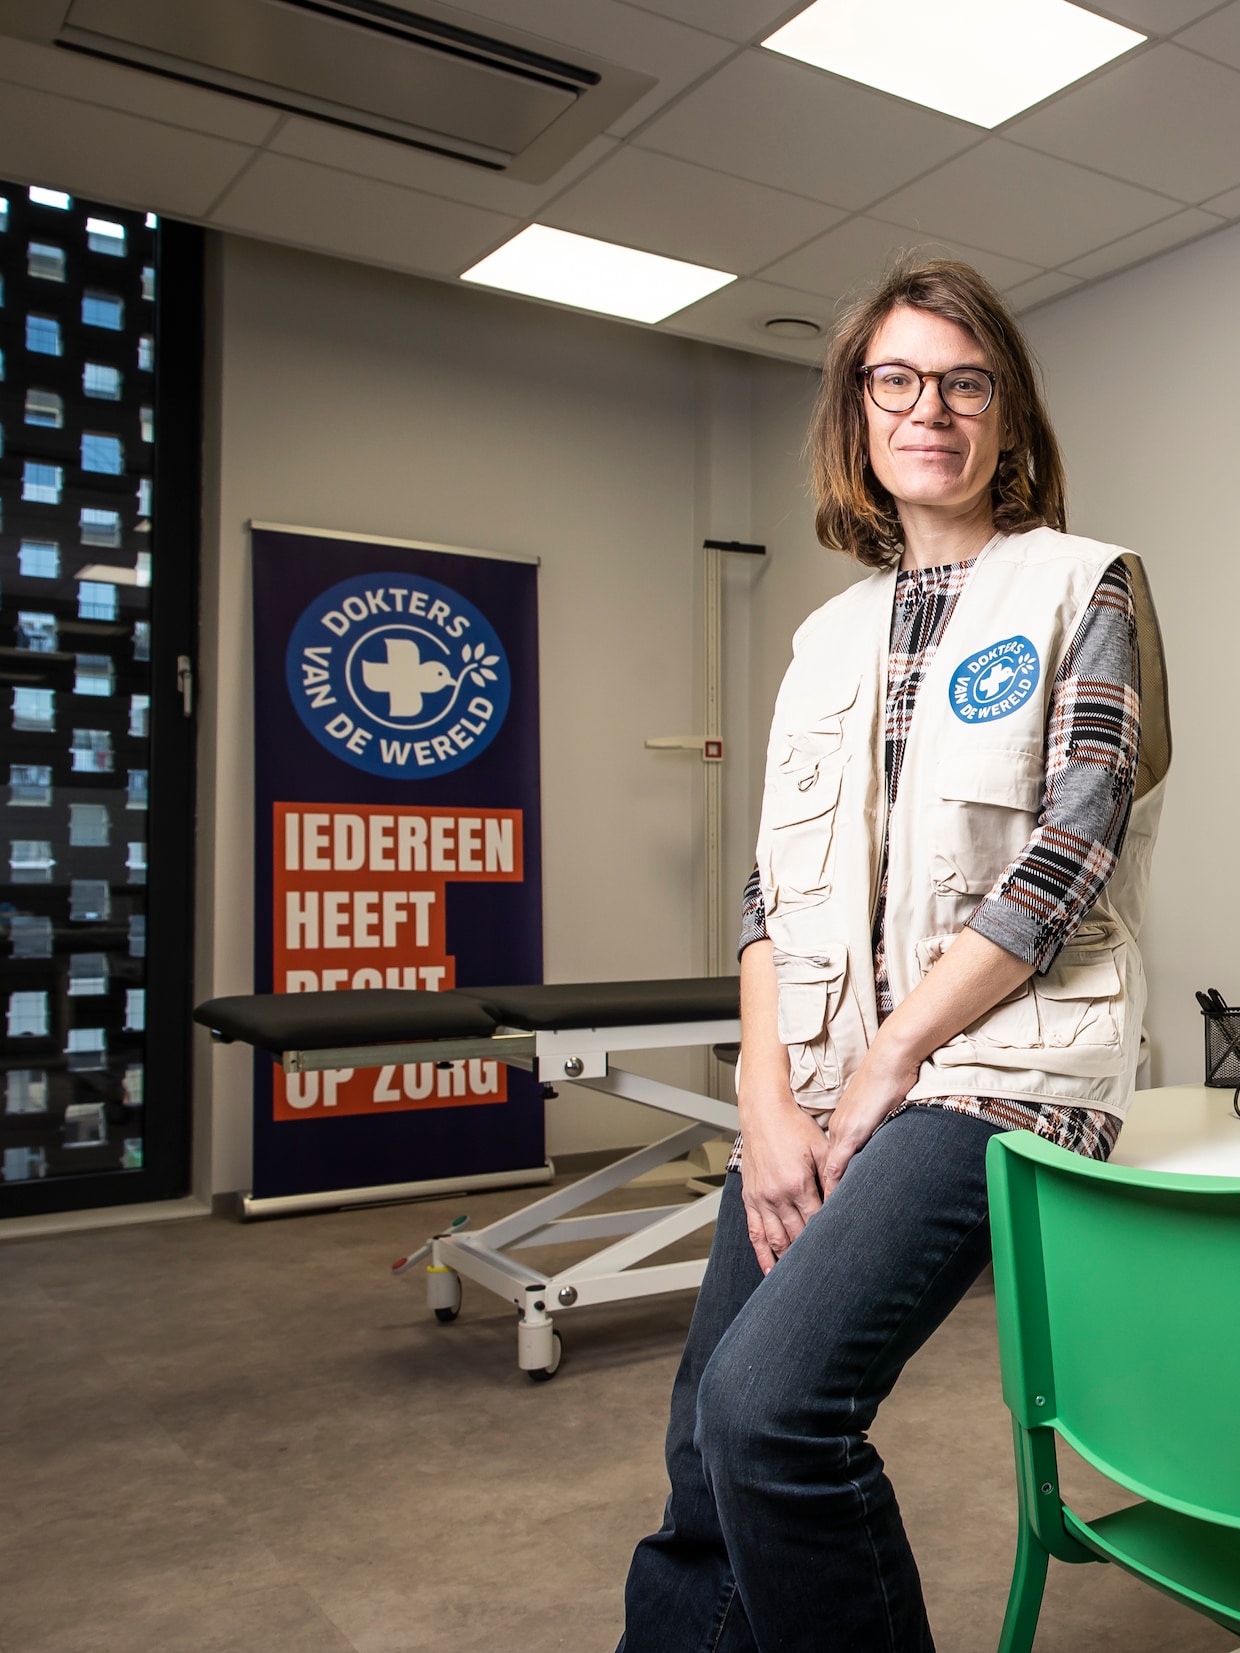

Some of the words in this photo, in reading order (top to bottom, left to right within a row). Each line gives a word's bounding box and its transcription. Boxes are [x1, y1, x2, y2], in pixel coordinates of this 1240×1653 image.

[321, 588, 470, 637] DOKTERS
[967, 641, 1025, 674] DOKTERS
[302, 647, 337, 708] VAN
[324, 713, 372, 755] DE
[379, 697, 494, 766] WERELD
[954, 677, 971, 704] VAN
[960, 704, 977, 719] DE
[978, 679, 1031, 718] WERELD
[285, 813, 514, 872] IEDEREEN
[286, 891, 436, 949] HEEFT
[286, 1067, 355, 1109] OP
[373, 1059, 498, 1103] ZORG
